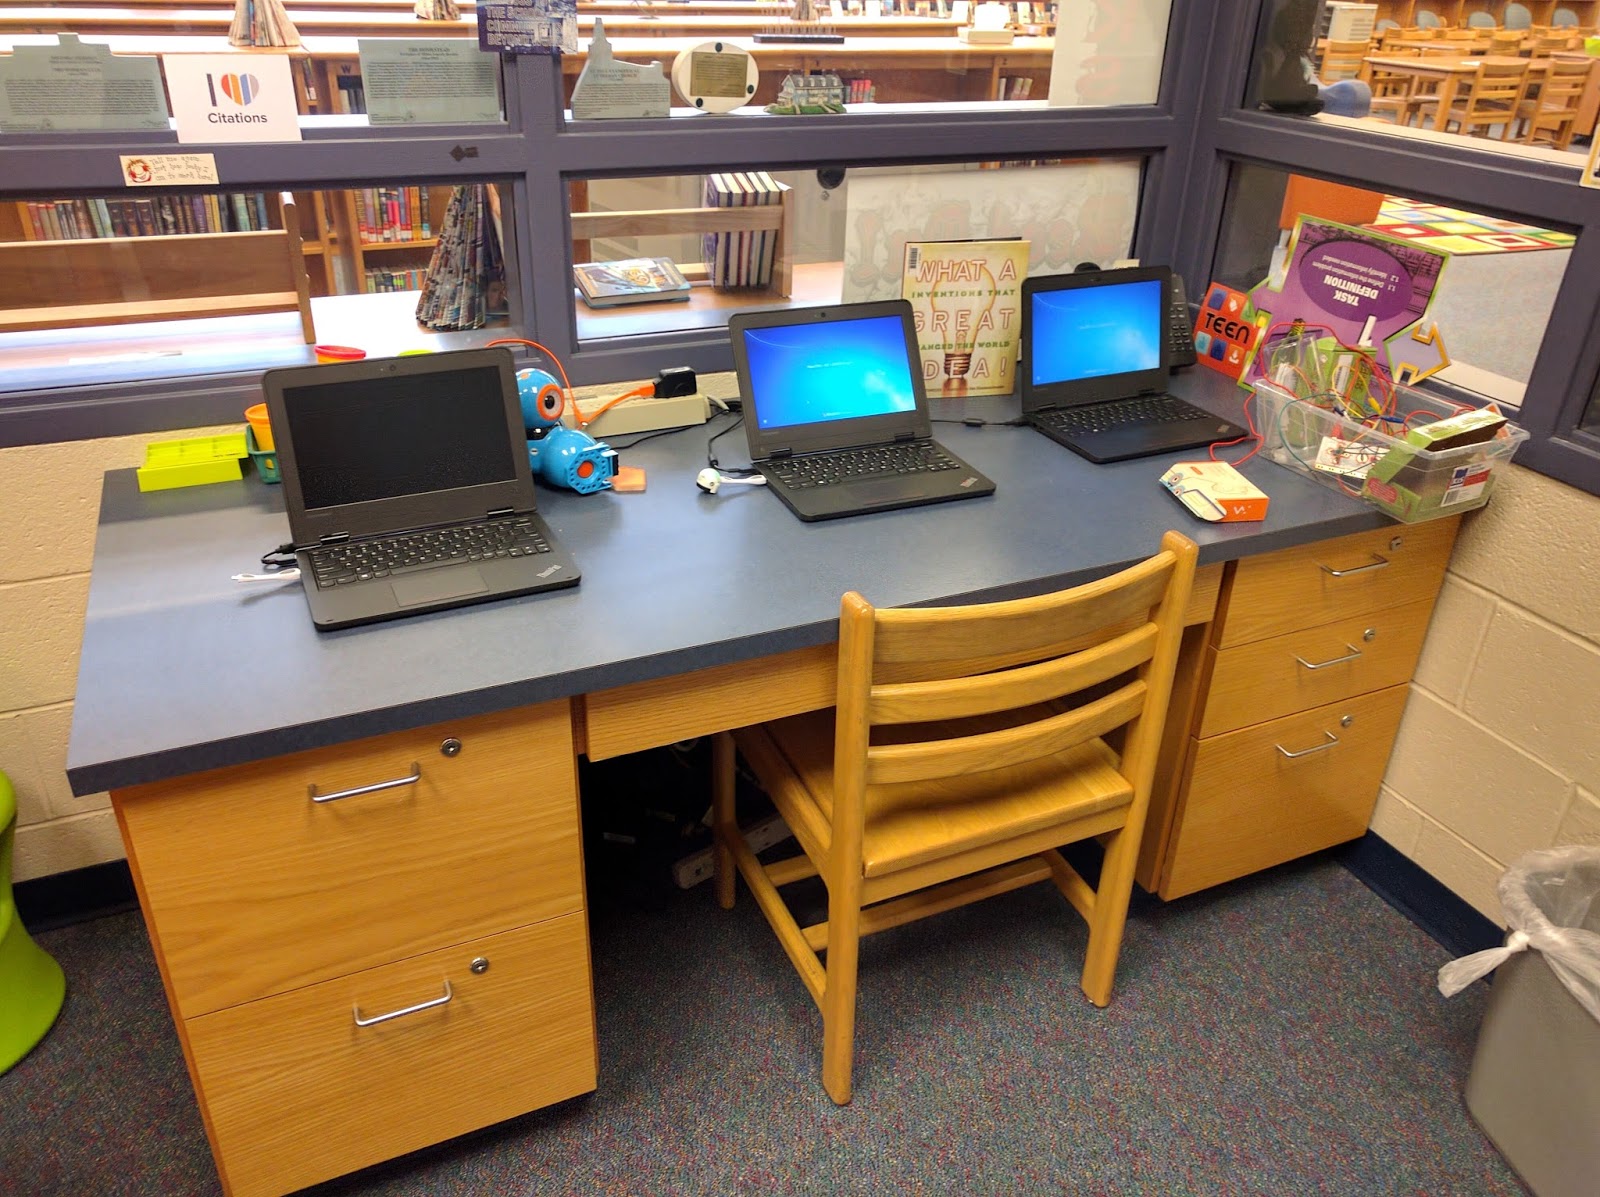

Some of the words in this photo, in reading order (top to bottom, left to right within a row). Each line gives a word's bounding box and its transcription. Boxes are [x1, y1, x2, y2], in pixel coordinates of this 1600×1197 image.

[206, 73, 218, 107] I
[207, 112, 268, 124] Citations
[916, 259, 987, 282] WHAT
[999, 258, 1016, 281] A
[1331, 266, 1360, 279] information
[911, 290, 983, 298] INVENTIONS
[1323, 274, 1379, 299] DEFINITION
[1367, 278, 1385, 288] Define
[1333, 289, 1360, 306] TASK
[913, 308, 1016, 332] GREAT
[1205, 311, 1250, 345] TEEN
[922, 356, 1007, 380] DEA!
